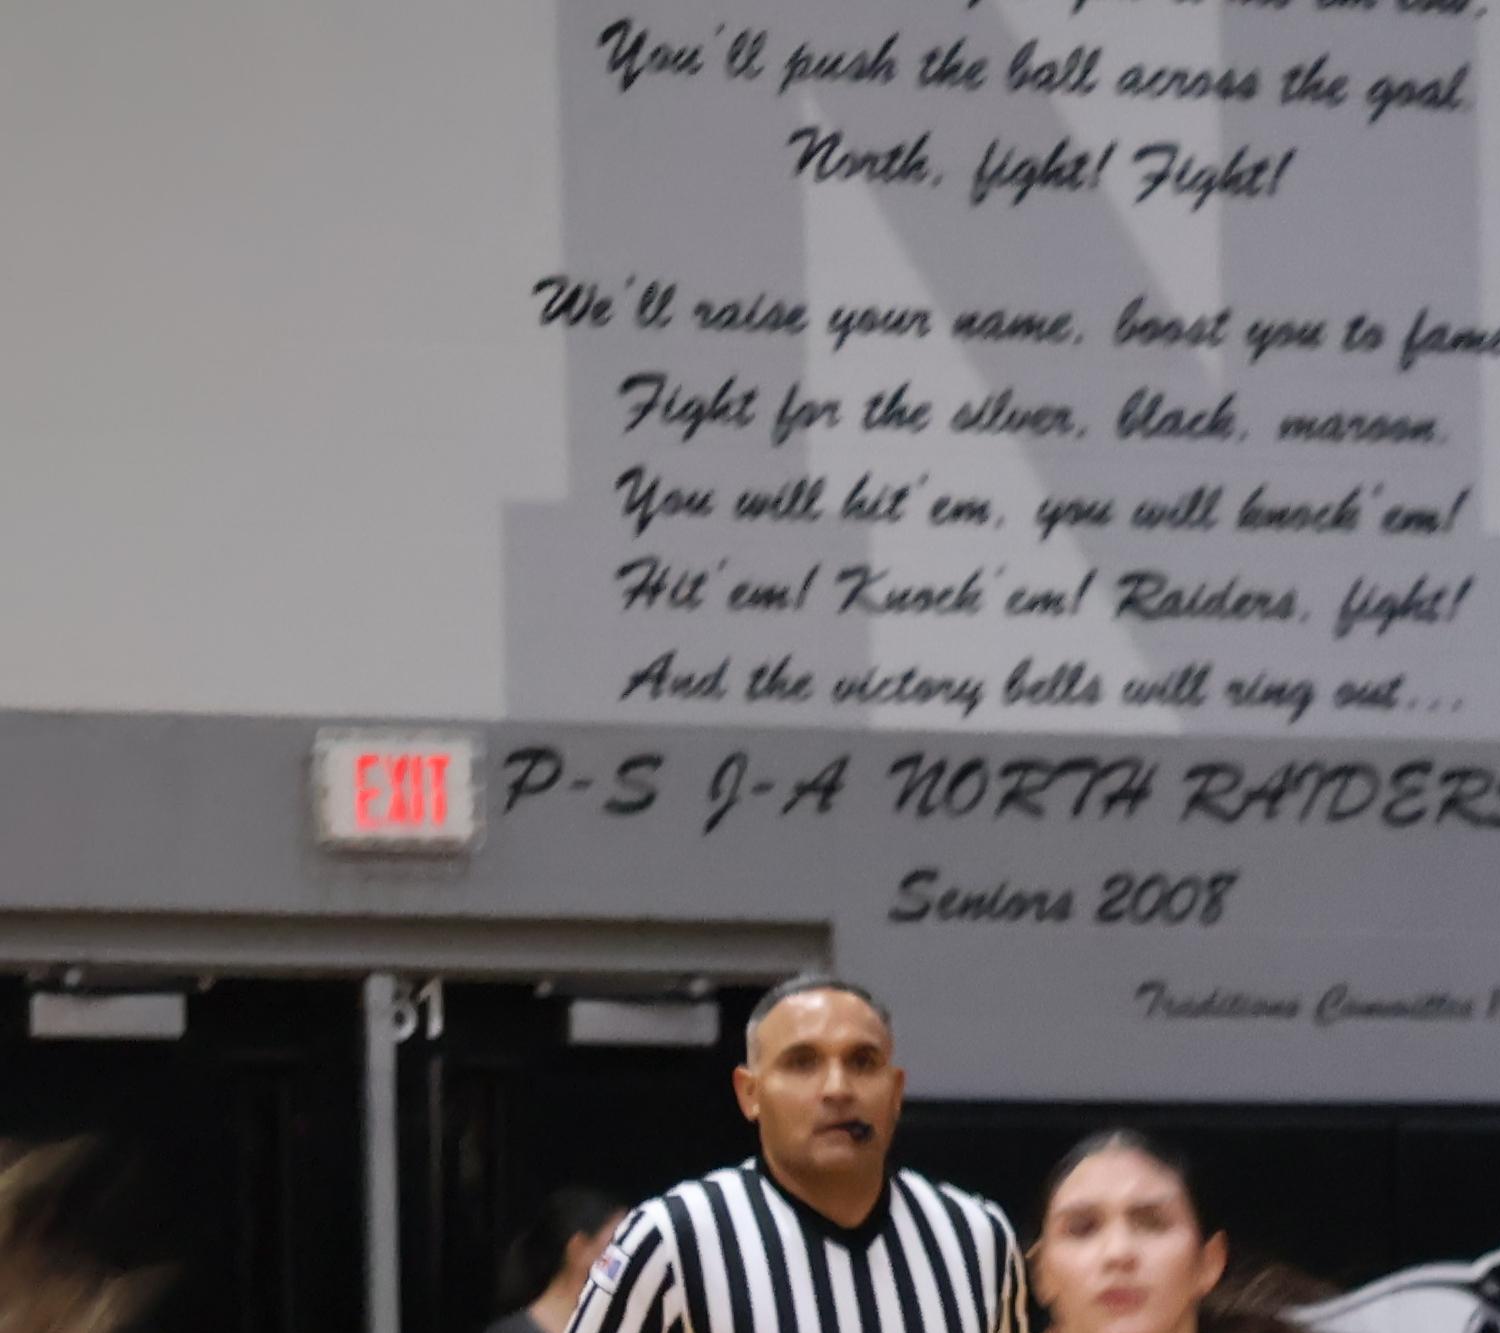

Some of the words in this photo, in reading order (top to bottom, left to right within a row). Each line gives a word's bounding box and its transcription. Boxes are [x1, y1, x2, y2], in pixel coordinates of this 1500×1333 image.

[597, 17, 767, 94] You'll
[778, 33, 899, 97] push
[917, 37, 990, 89] the
[1005, 38, 1103, 96] ball
[1115, 63, 1260, 99] across
[1280, 52, 1350, 107] the
[786, 125, 943, 187] North,
[969, 136, 1118, 206] fight!
[1132, 143, 1298, 213] Fight!
[531, 274, 677, 330] We'll
[693, 294, 809, 335] raise
[825, 305, 932, 352] your
[951, 305, 1083, 346] name,
[1114, 296, 1232, 347] boost
[1245, 317, 1328, 366] you
[1342, 314, 1387, 353] to
[618, 370, 762, 444] Fight
[770, 382, 844, 448] for
[861, 381, 932, 436] the
[951, 387, 1088, 440] silver,
[1116, 386, 1250, 443] black,
[614, 464, 717, 542] You
[732, 475, 829, 523] will
[1035, 497, 1117, 543] you
[1131, 483, 1225, 531] will
[1110, 568, 1312, 623] Raiders,
[1330, 573, 1475, 642] fight!
[617, 647, 731, 703] And
[743, 652, 816, 706] the
[829, 664, 987, 720] victory
[1003, 655, 1105, 708] bells
[1121, 660, 1214, 709] will
[1224, 669, 1317, 726] ring
[354, 752, 451, 830] EXIT
[886, 750, 1160, 822] NORTH
[887, 867, 1076, 925] Seniors
[1095, 867, 1241, 928] 2008
